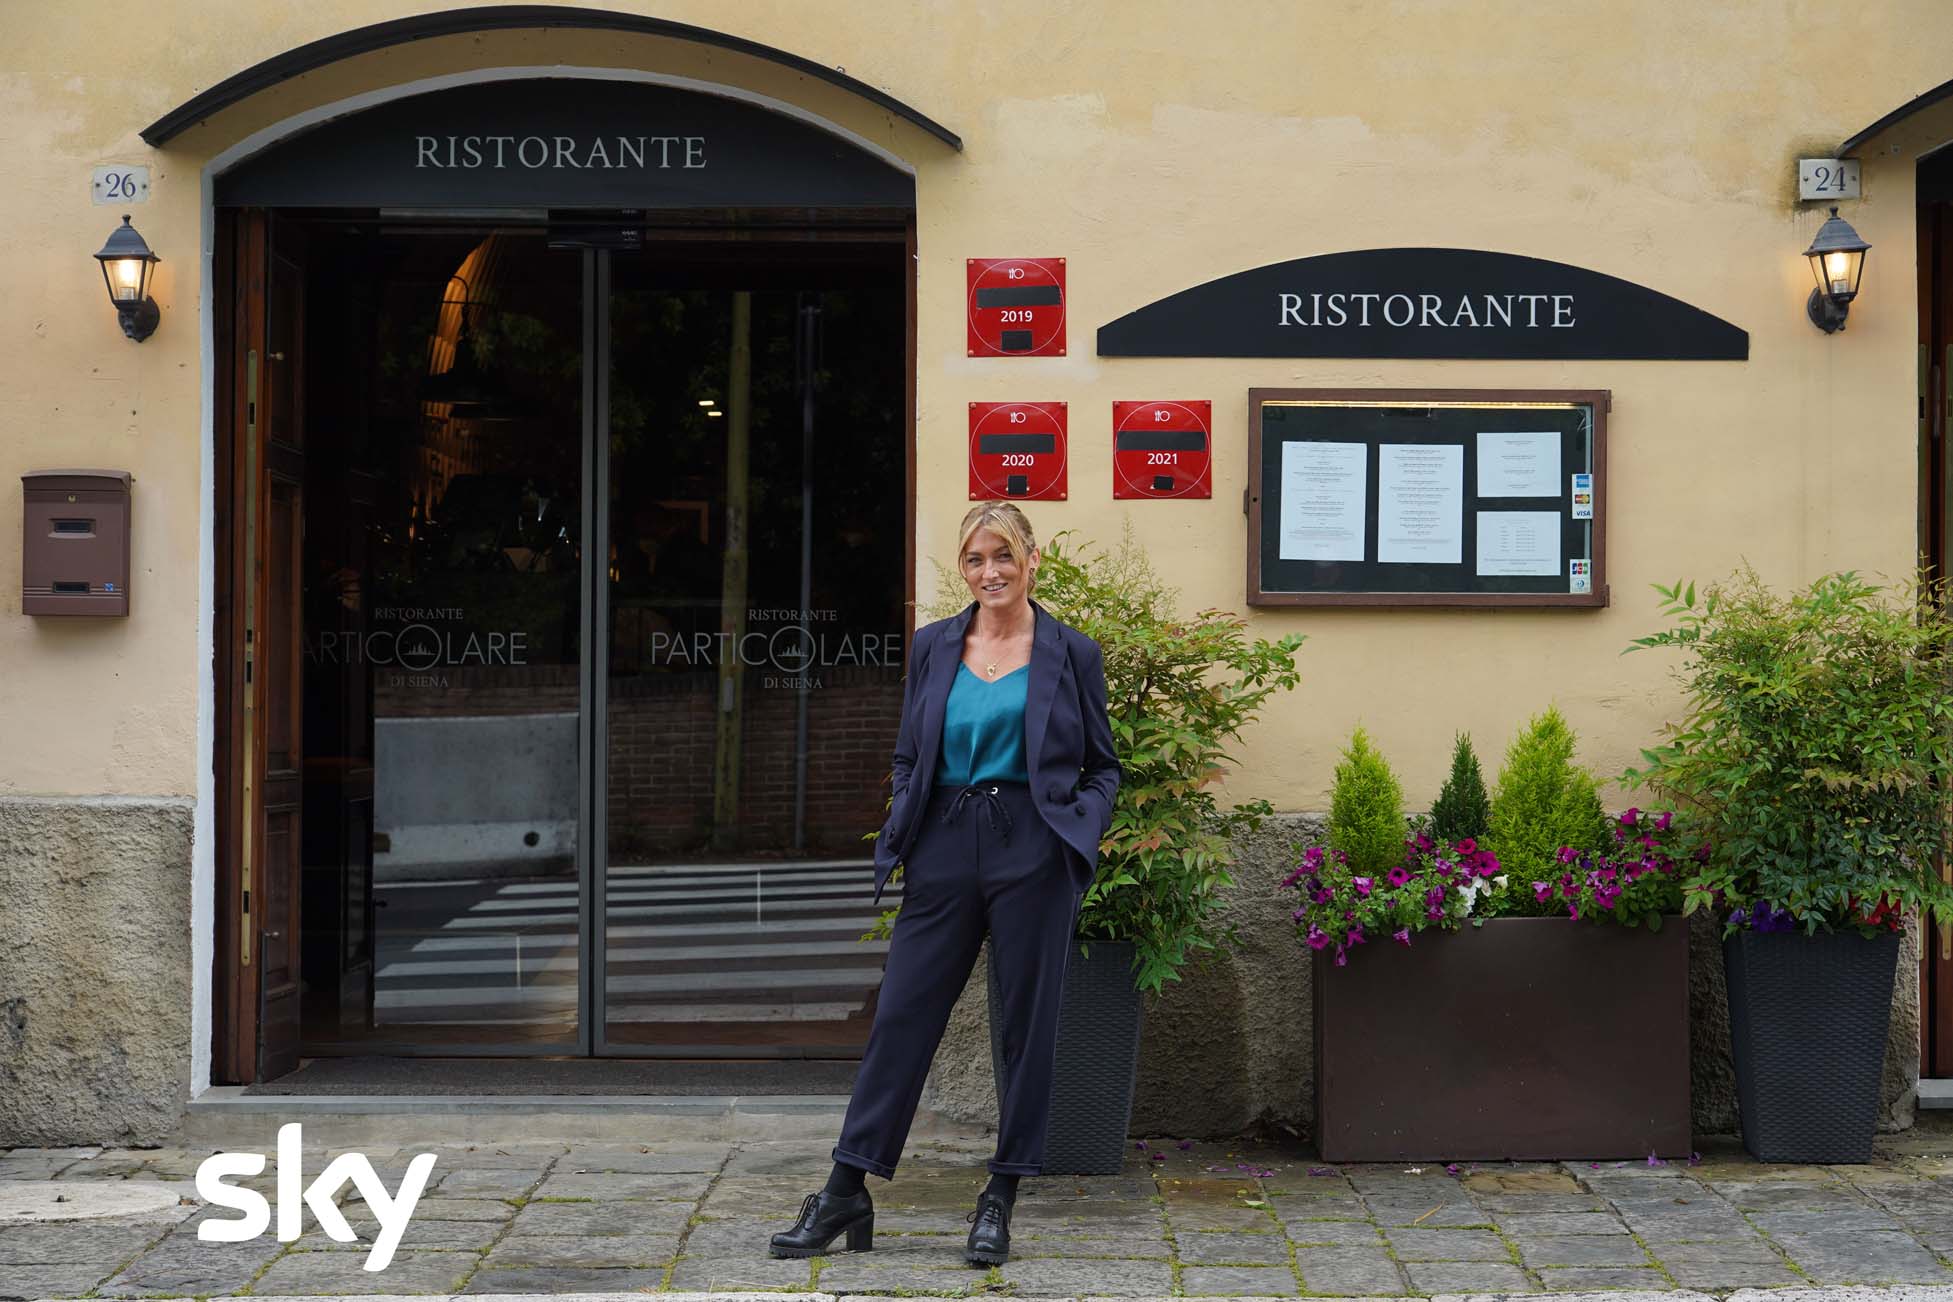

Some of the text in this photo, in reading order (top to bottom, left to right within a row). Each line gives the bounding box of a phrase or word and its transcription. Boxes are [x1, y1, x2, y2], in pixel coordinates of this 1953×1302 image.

[415, 136, 707, 168] RISTORANTE
[105, 172, 136, 198] 26
[1814, 166, 1846, 192] 24
[1000, 310, 1033, 322] 2019
[1278, 293, 1576, 327] RISTORANTE
[1002, 454, 1034, 466] 2020
[1147, 453, 1178, 465] 2021
[375, 607, 464, 621] RISTORANTE
[748, 609, 838, 622] RISTORANTE
[301, 624, 527, 671] ARTICOLARE
[651, 625, 902, 673] PARTICOLARE
[391, 676, 449, 688] DI SIENA
[764, 677, 823, 689] DI SIENA
